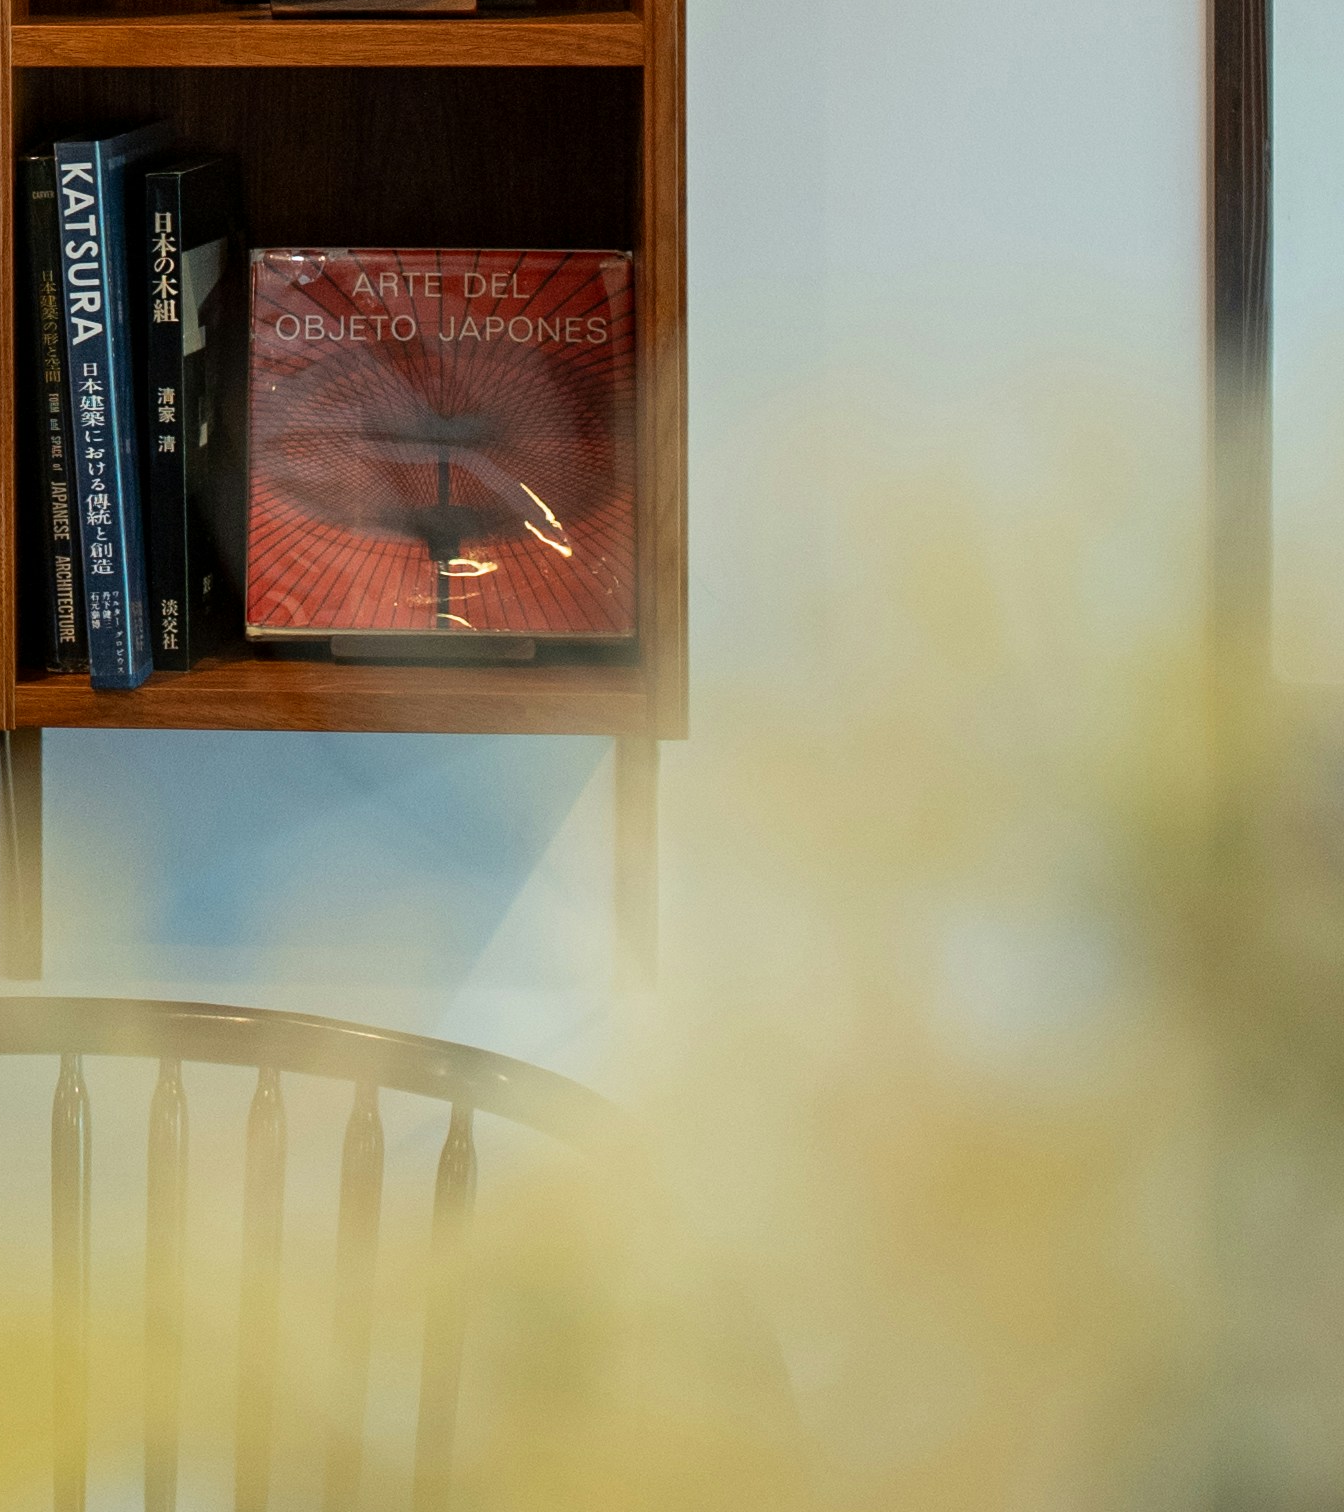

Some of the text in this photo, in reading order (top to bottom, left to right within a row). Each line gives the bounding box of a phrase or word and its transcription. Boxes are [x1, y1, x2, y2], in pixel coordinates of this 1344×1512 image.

[61, 162, 103, 346] KATSURA
[151, 211, 180, 325] 日本の木組
[351, 272, 530, 299] ARTE DEL
[275, 314, 608, 344] OBJETO JAPONES
[50, 435, 62, 458] SPACE
[157, 386, 177, 454] 清家 清
[78, 362, 115, 575] 日本建築における傳統と創造
[50, 481, 71, 541] JAPANESE
[55, 555, 76, 644] ARCHITECTURE
[160, 598, 180, 651] 淡交社
